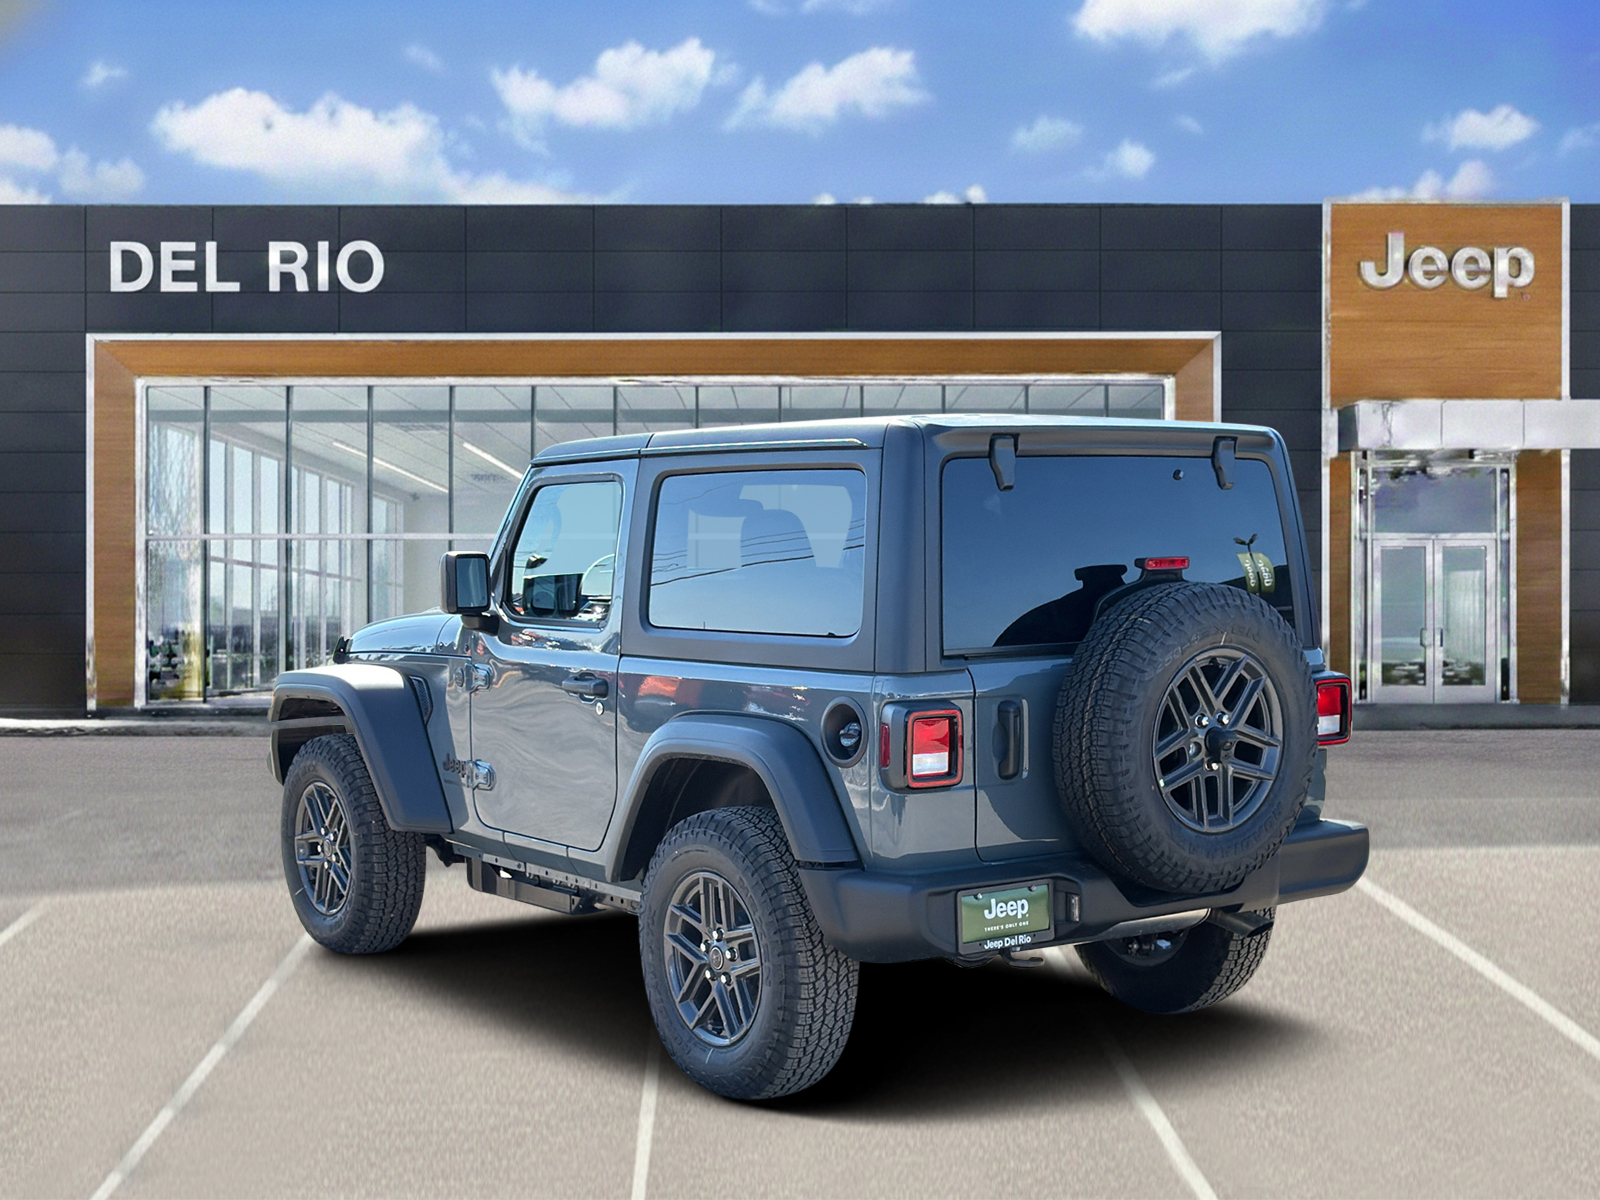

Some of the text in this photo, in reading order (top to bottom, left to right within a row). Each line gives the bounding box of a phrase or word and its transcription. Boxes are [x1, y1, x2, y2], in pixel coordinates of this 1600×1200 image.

[110, 240, 385, 293] DEL RIO
[1360, 231, 1535, 298] Jeep
[984, 898, 1029, 919] Jeep
[984, 924, 1004, 932] THERE'S
[984, 934, 1031, 950] Jeep Del Rio
